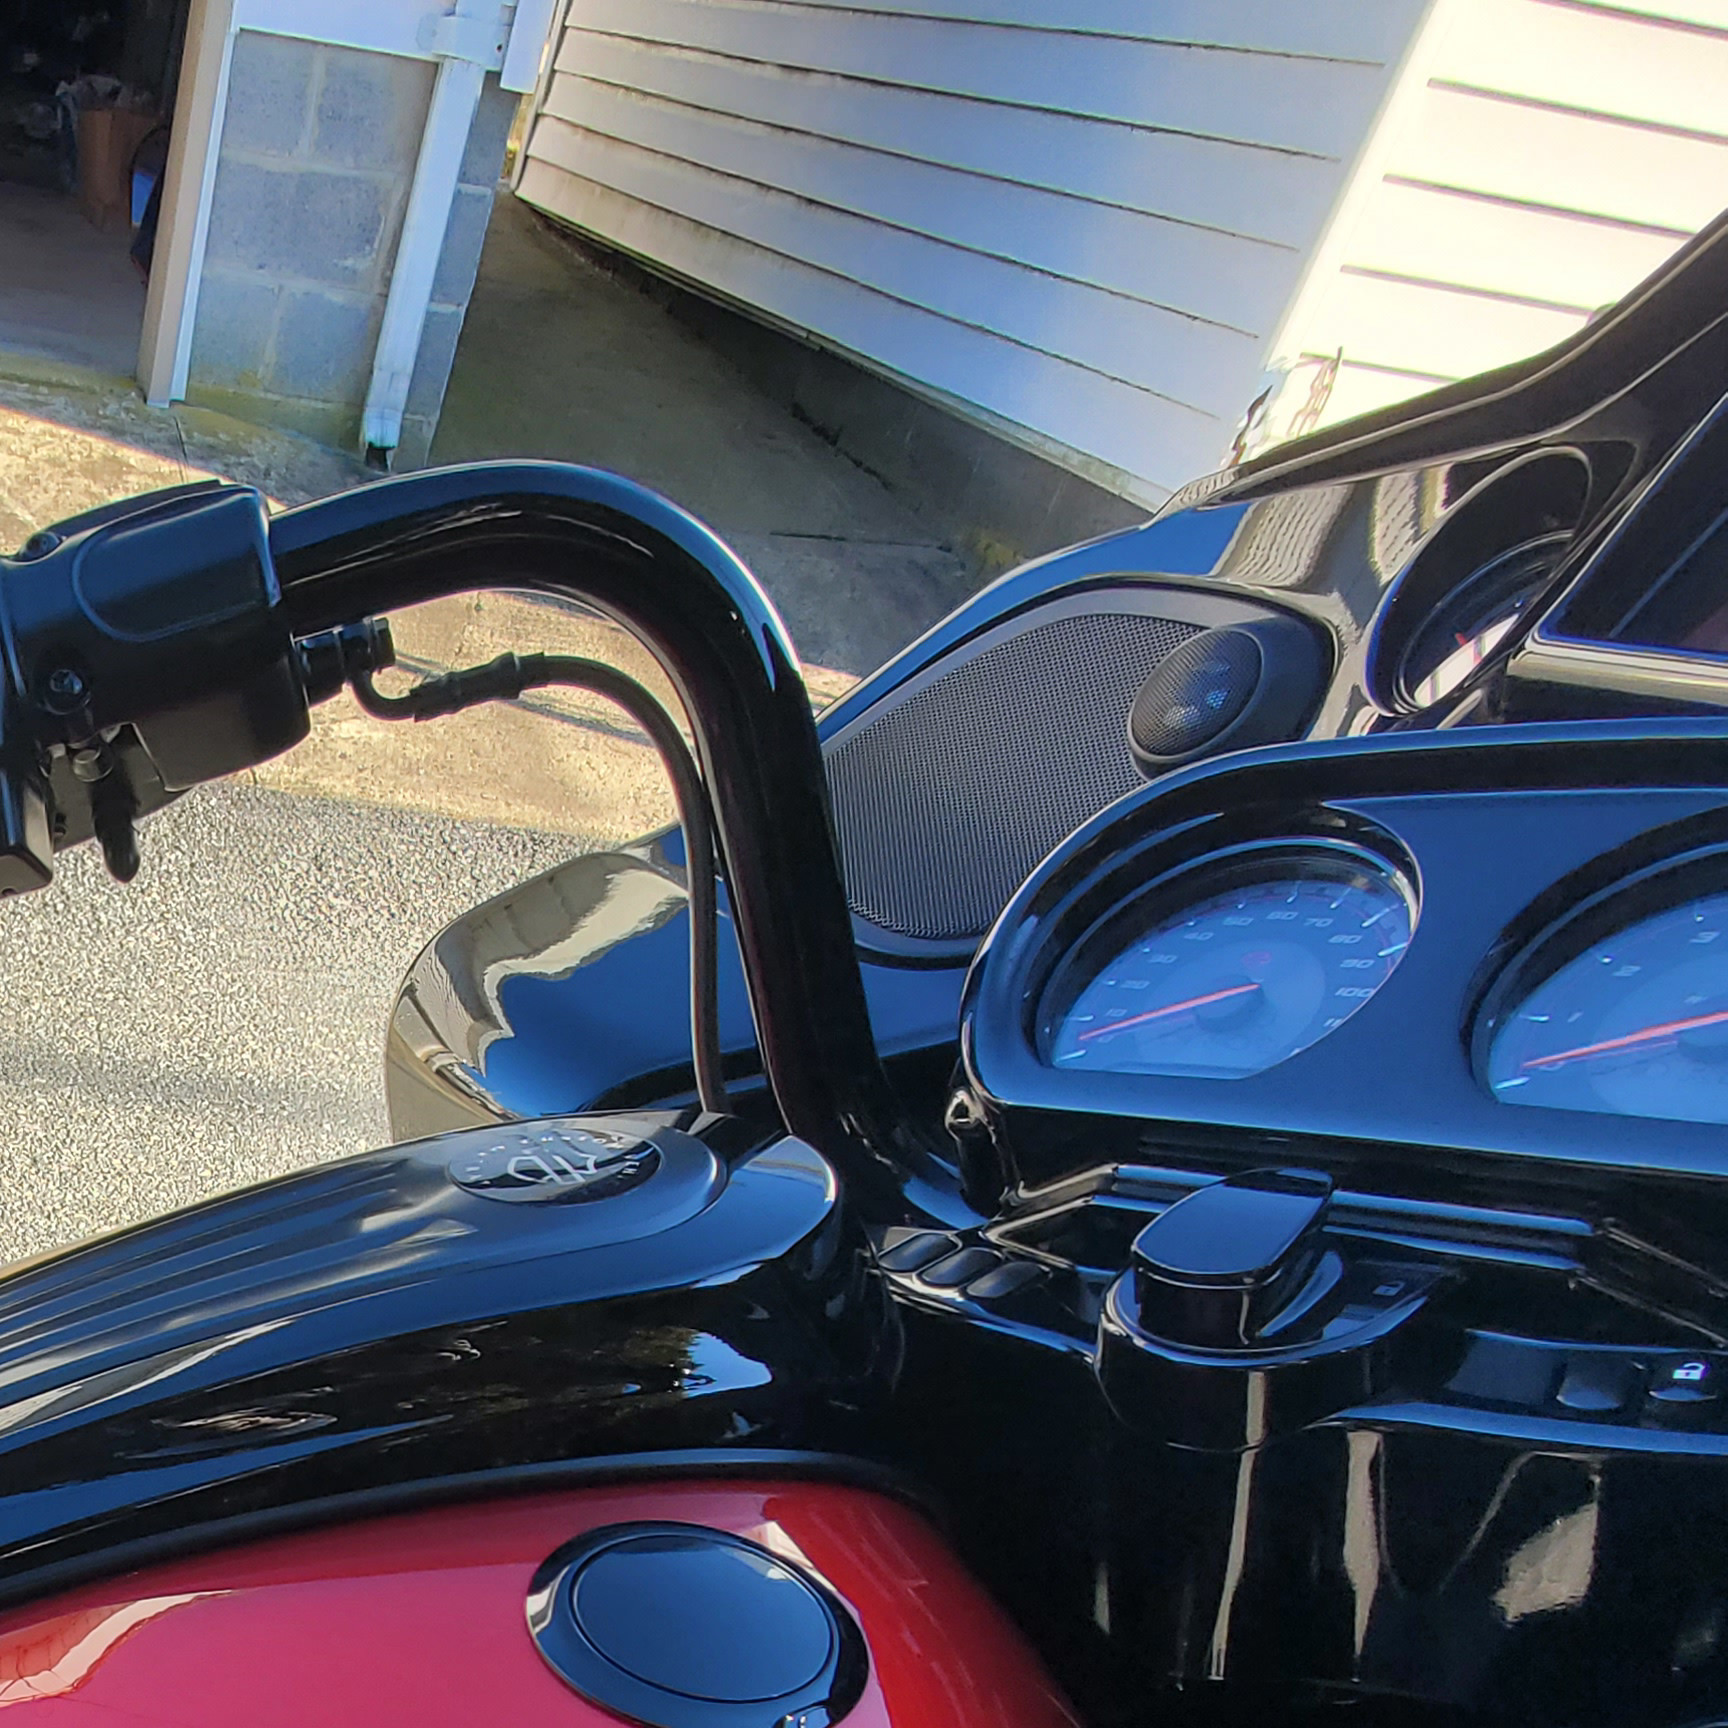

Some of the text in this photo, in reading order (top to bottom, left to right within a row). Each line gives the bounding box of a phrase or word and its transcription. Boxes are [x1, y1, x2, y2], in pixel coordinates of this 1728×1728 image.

[1303, 917, 1333, 927] 70
[1184, 932, 1214, 941] 40
[1689, 931, 1720, 944] 3
[1613, 965, 1642, 977] 2
[1334, 987, 1374, 998] 100
